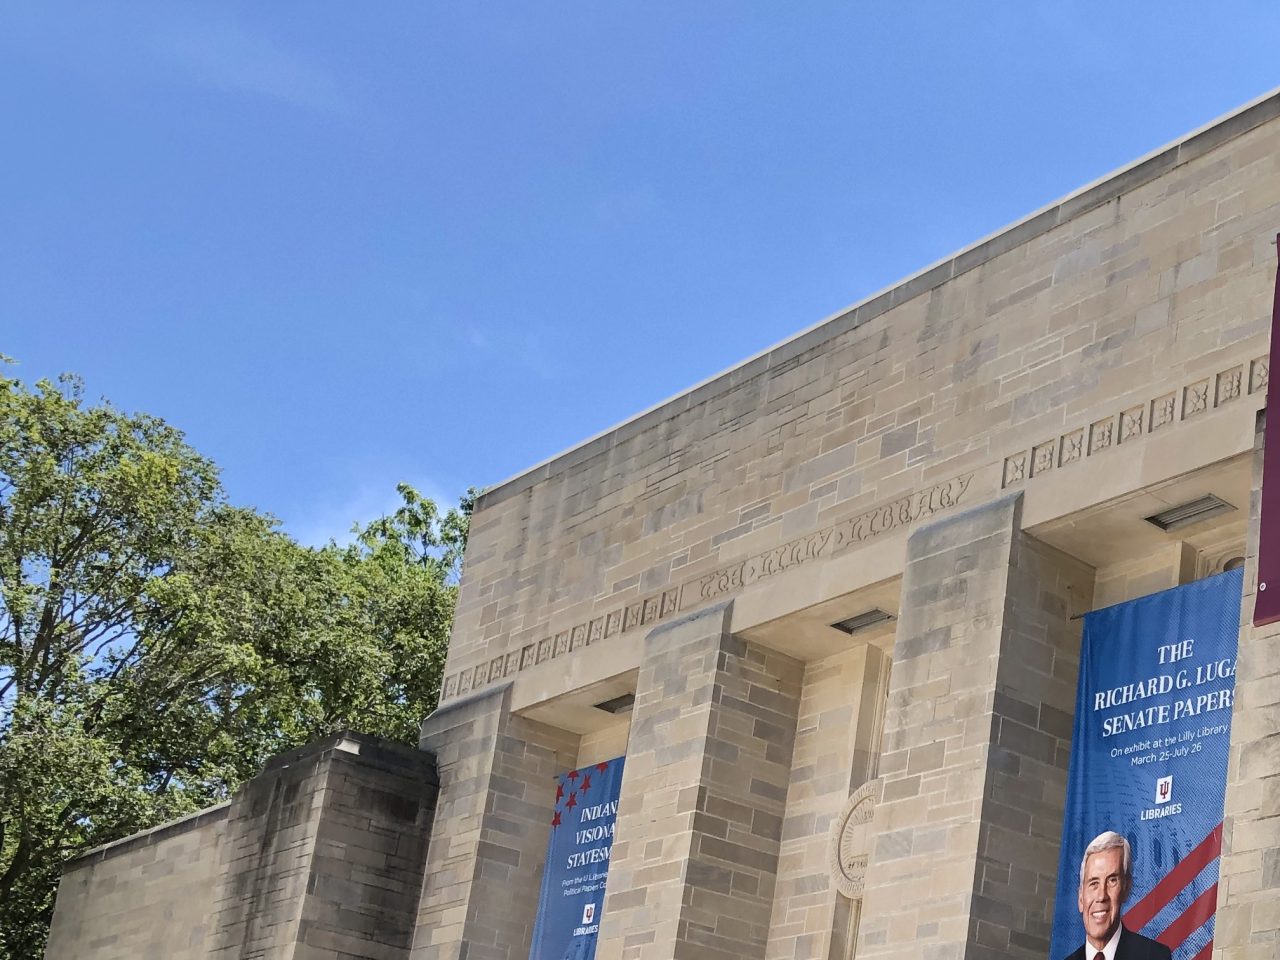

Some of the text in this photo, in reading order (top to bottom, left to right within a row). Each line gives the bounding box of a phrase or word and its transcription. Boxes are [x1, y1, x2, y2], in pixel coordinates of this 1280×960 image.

[847, 474, 975, 547] LIBRARY
[1157, 639, 1195, 665] THE
[1094, 675, 1174, 712] RICHARD
[1176, 670, 1192, 690] G.
[1102, 704, 1171, 738] SENATE
[1110, 723, 1229, 758] On exhibit at the Lilly Library
[1130, 743, 1202, 767] March 25-July 26
[1140, 803, 1182, 821] LIBRARIES
